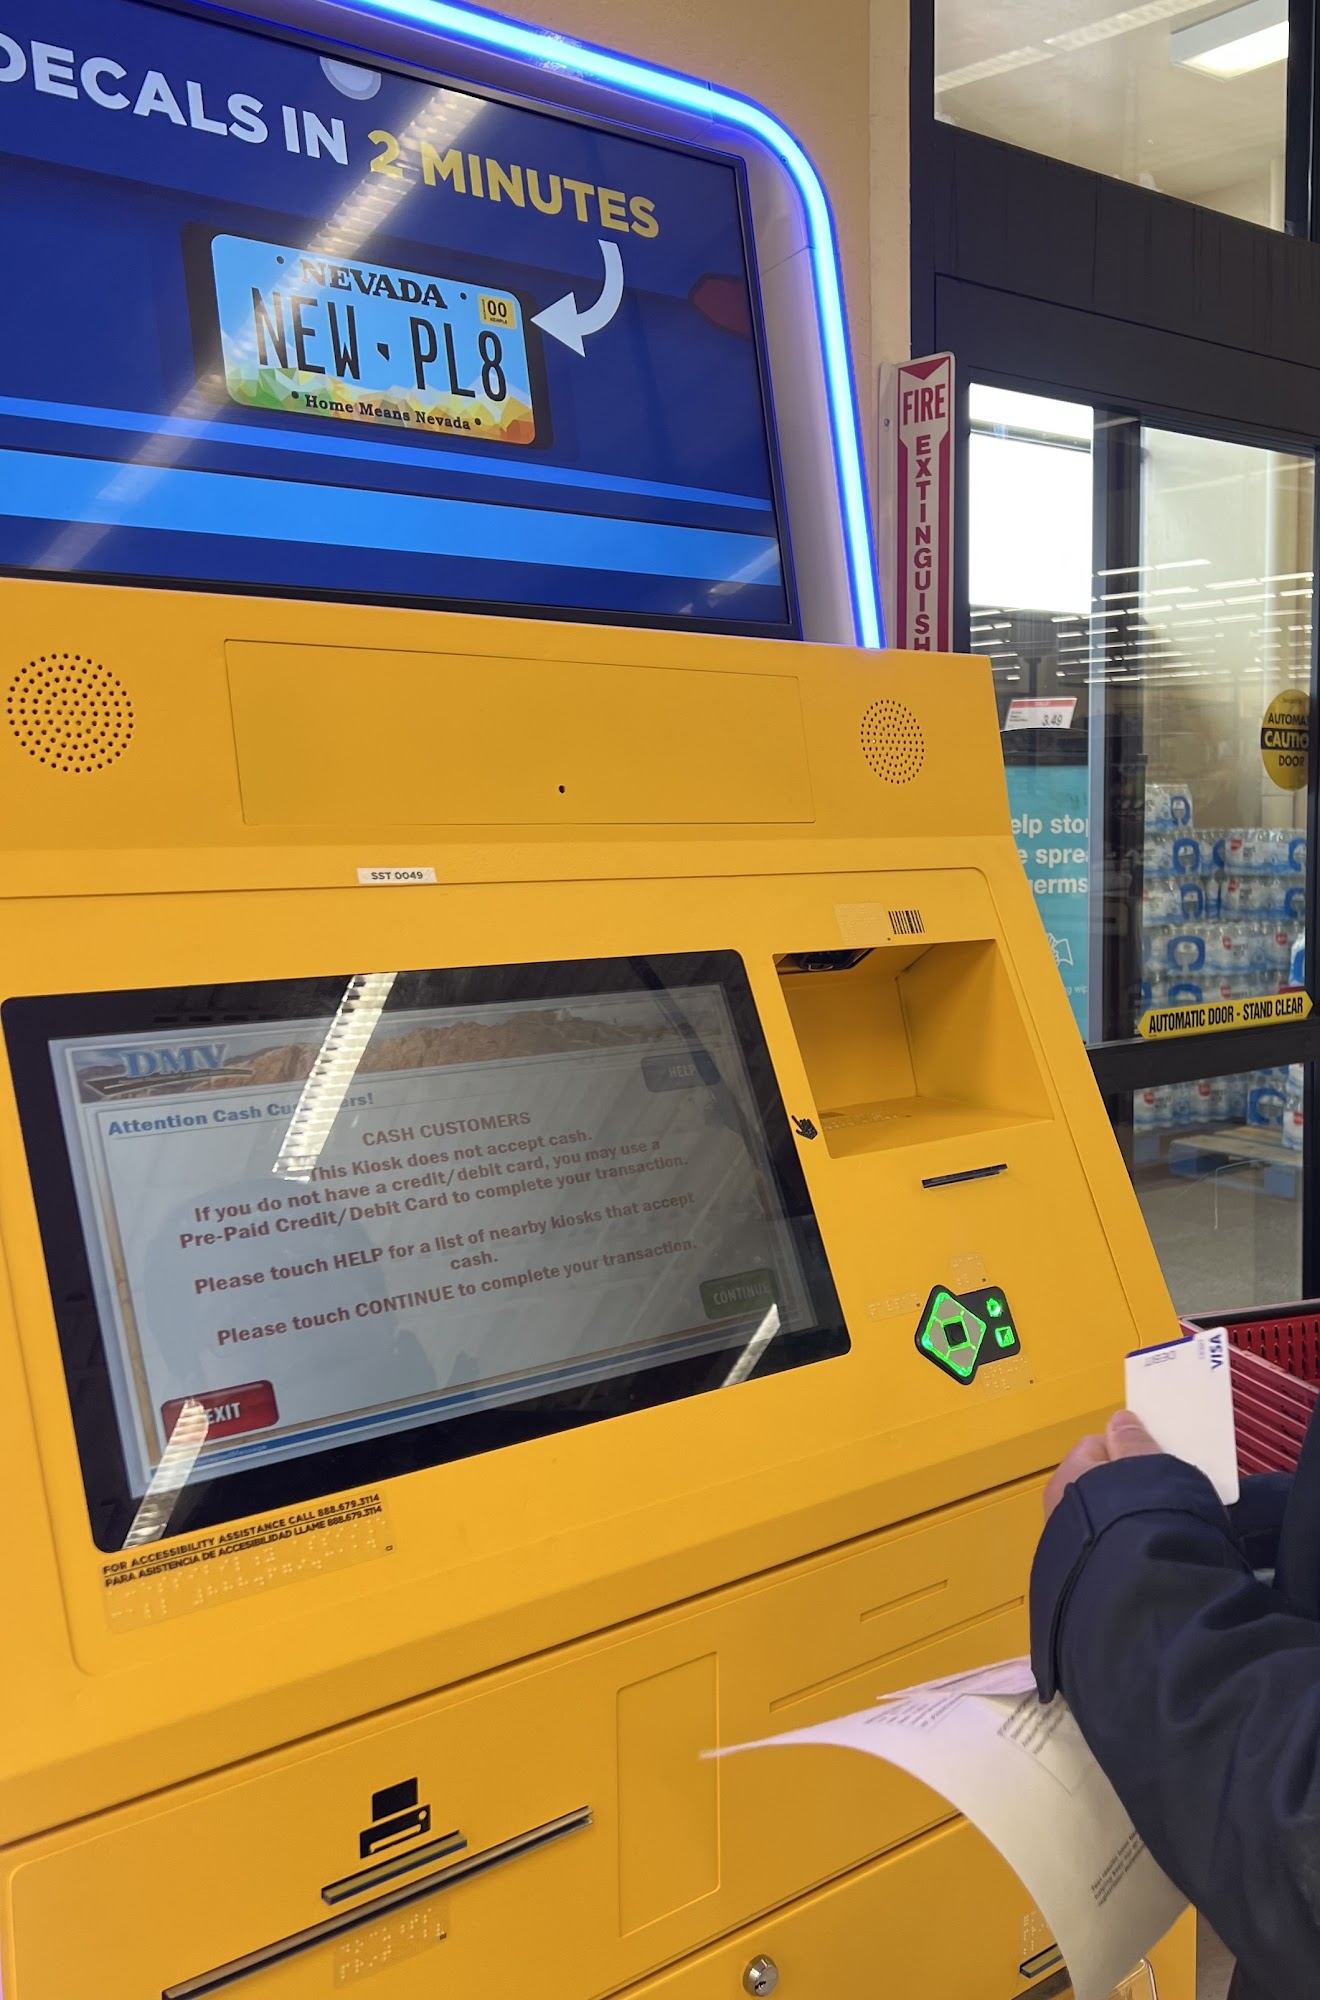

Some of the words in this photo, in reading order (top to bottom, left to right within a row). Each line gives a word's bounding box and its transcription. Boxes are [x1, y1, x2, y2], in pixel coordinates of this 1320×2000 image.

[282, 105, 348, 165] IN
[368, 129, 404, 178] 2
[421, 141, 660, 238] MINUTES
[300, 258, 448, 309] NEVADA
[487, 300, 507, 317] 00
[252, 287, 360, 380] NEW
[409, 316, 507, 402] PL8
[304, 394, 354, 413] Home
[359, 402, 411, 422] Means
[415, 410, 472, 430] Nevada
[902, 383, 946, 426] FIRE
[913, 434, 932, 651] EXTINGUISH
[1268, 713, 1307, 725] AUTOMA
[1264, 730, 1309, 748] CAUTIO
[1279, 755, 1305, 766] DOOR
[1011, 814, 1043, 838] elp
[1050, 814, 1088, 837] sto
[371, 872, 391, 880] SST
[395, 871, 423, 880] 0049
[1035, 848, 1088, 868] spre
[1028, 877, 1088, 895] erms
[1149, 1010, 1205, 1034] AUTOMATIC
[1208, 1006, 1234, 1026] DOOR
[1243, 999, 1273, 1021] STAND
[1275, 996, 1304, 1016] CLEAR
[122, 1044, 227, 1078] DMV
[108, 1113, 208, 1136] Attention
[213, 1105, 262, 1123] Cash
[362, 1127, 415, 1147] CASH
[420, 1111, 532, 1139] CUSTOMERS
[352, 1156, 403, 1176] Kiosk
[407, 1153, 449, 1168] does
[454, 1145, 484, 1161] not
[488, 1136, 546, 1154] accept
[549, 1129, 593, 1147] cash.
[194, 1207, 210, 1223] If
[215, 1202, 251, 1223] you
[257, 1197, 282, 1213] do
[288, 1190, 321, 1208] not
[325, 1183, 370, 1202] have
[376, 1183, 387, 1194] a
[392, 1161, 503, 1193] credit/debit
[506, 1155, 550, 1173] card,
[553, 1149, 582, 1169] you
[585, 1146, 617, 1162] may
[621, 1142, 648, 1156] use
[651, 1139, 661, 1151] a
[179, 1220, 271, 1249] Pre-Paid
[275, 1199, 401, 1234] Credit/Debit
[405, 1192, 449, 1212] Card
[452, 1189, 471, 1204] to
[475, 1175, 553, 1200] complete
[556, 1170, 592, 1190] your
[595, 1154, 689, 1180] transaction.
[195, 1268, 265, 1295] Please
[270, 1258, 329, 1281] touch
[333, 1247, 384, 1270] HELP
[388, 1244, 415, 1260] for
[419, 1242, 431, 1254] a
[435, 1234, 465, 1251] list
[468, 1229, 485, 1245] of
[489, 1219, 547, 1242] nearby
[551, 1209, 603, 1230] kiosks
[605, 1201, 640, 1220] that
[643, 1191, 695, 1213] accept
[450, 1250, 499, 1271] cash.
[217, 1321, 288, 1346] Please
[292, 1306, 351, 1331] touch
[355, 1284, 455, 1318] CONTINUE
[458, 1282, 477, 1298] to
[481, 1266, 561, 1293] complete
[563, 1258, 599, 1279] your
[602, 1238, 698, 1267] transaction.
[713, 1283, 771, 1305] CONTINUE
[1210, 1334, 1223, 1370] VISA
[204, 1402, 241, 1425] EXIT
[103, 1560, 127, 1575] FOR
[131, 1537, 215, 1567] ACCESSIBILITY
[219, 1519, 287, 1544] ASSISTANCE
[288, 1511, 316, 1526] CALL
[105, 1571, 136, 1588] PARA
[138, 1554, 201, 1580] ASISTENCIA
[202, 1549, 217, 1562] DE
[218, 1530, 292, 1557] ACCESIBILIDAD
[294, 1520, 326, 1537] LLAME
